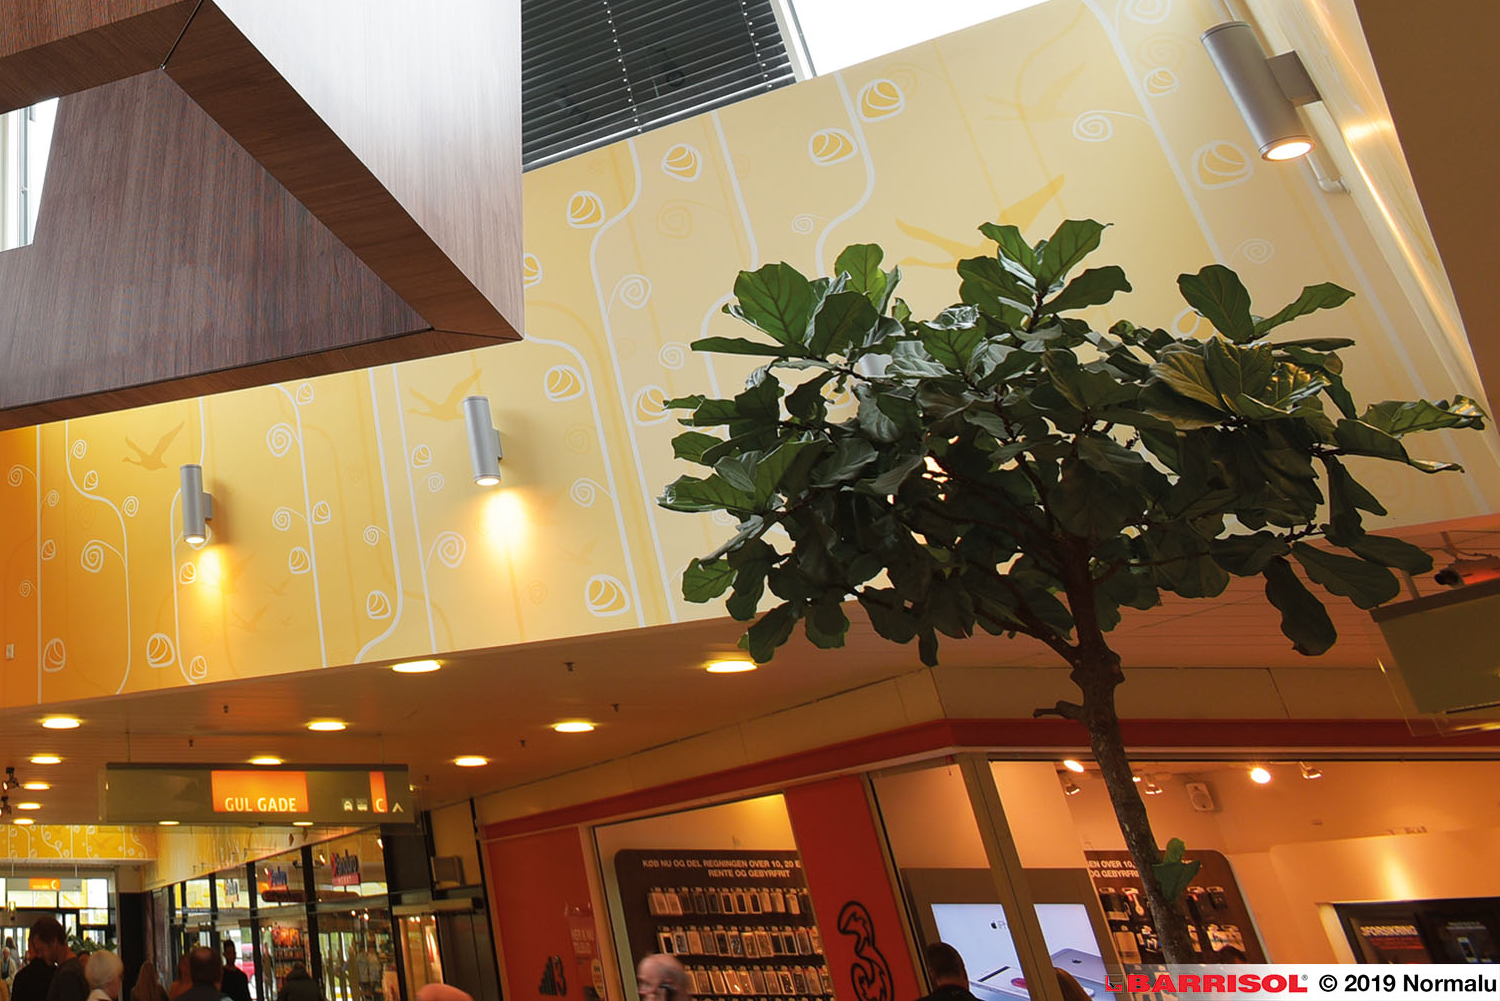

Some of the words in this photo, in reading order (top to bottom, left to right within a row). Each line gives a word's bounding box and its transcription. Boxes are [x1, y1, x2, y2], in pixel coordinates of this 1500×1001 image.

[224, 797, 253, 812] GUL
[257, 798, 297, 812] GADE
[375, 799, 385, 812] C
[661, 860, 672, 868] NU
[674, 860, 686, 868] OG
[687, 860, 702, 868] DEL
[749, 860, 770, 868] OVER
[771, 860, 783, 869] 10,
[784, 860, 794, 868] 20
[1100, 860, 1122, 869] OVER
[708, 870, 734, 878] RENTE
[735, 870, 747, 878] OG
[1102, 870, 1140, 878] GEBYRFRI
